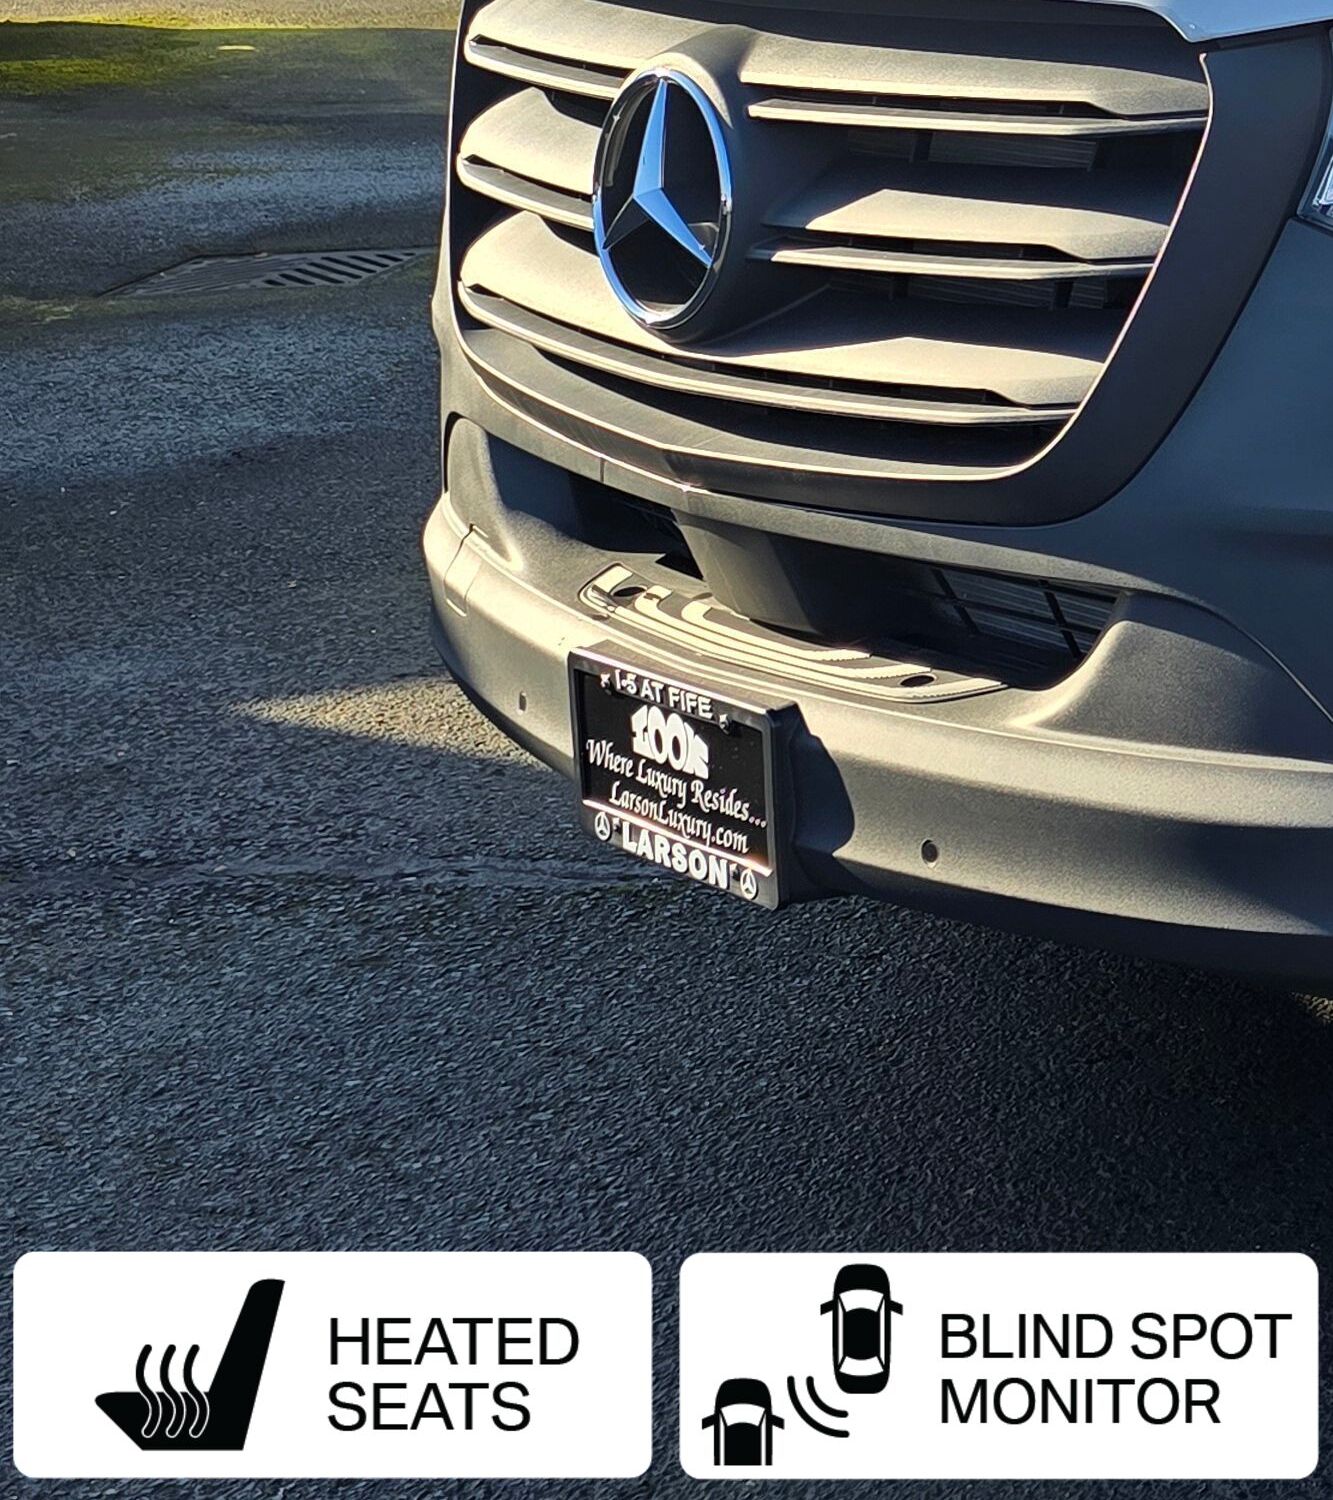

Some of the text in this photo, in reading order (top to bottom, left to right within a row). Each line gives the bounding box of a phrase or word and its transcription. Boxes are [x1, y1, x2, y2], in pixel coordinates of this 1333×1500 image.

[640, 681, 664, 703] AT
[668, 689, 714, 720] FIFE
[586, 739, 634, 777] Where
[636, 758, 687, 809] Luxury
[609, 781, 749, 854] LarsonLuxury.com
[621, 821, 729, 890] LARSON
